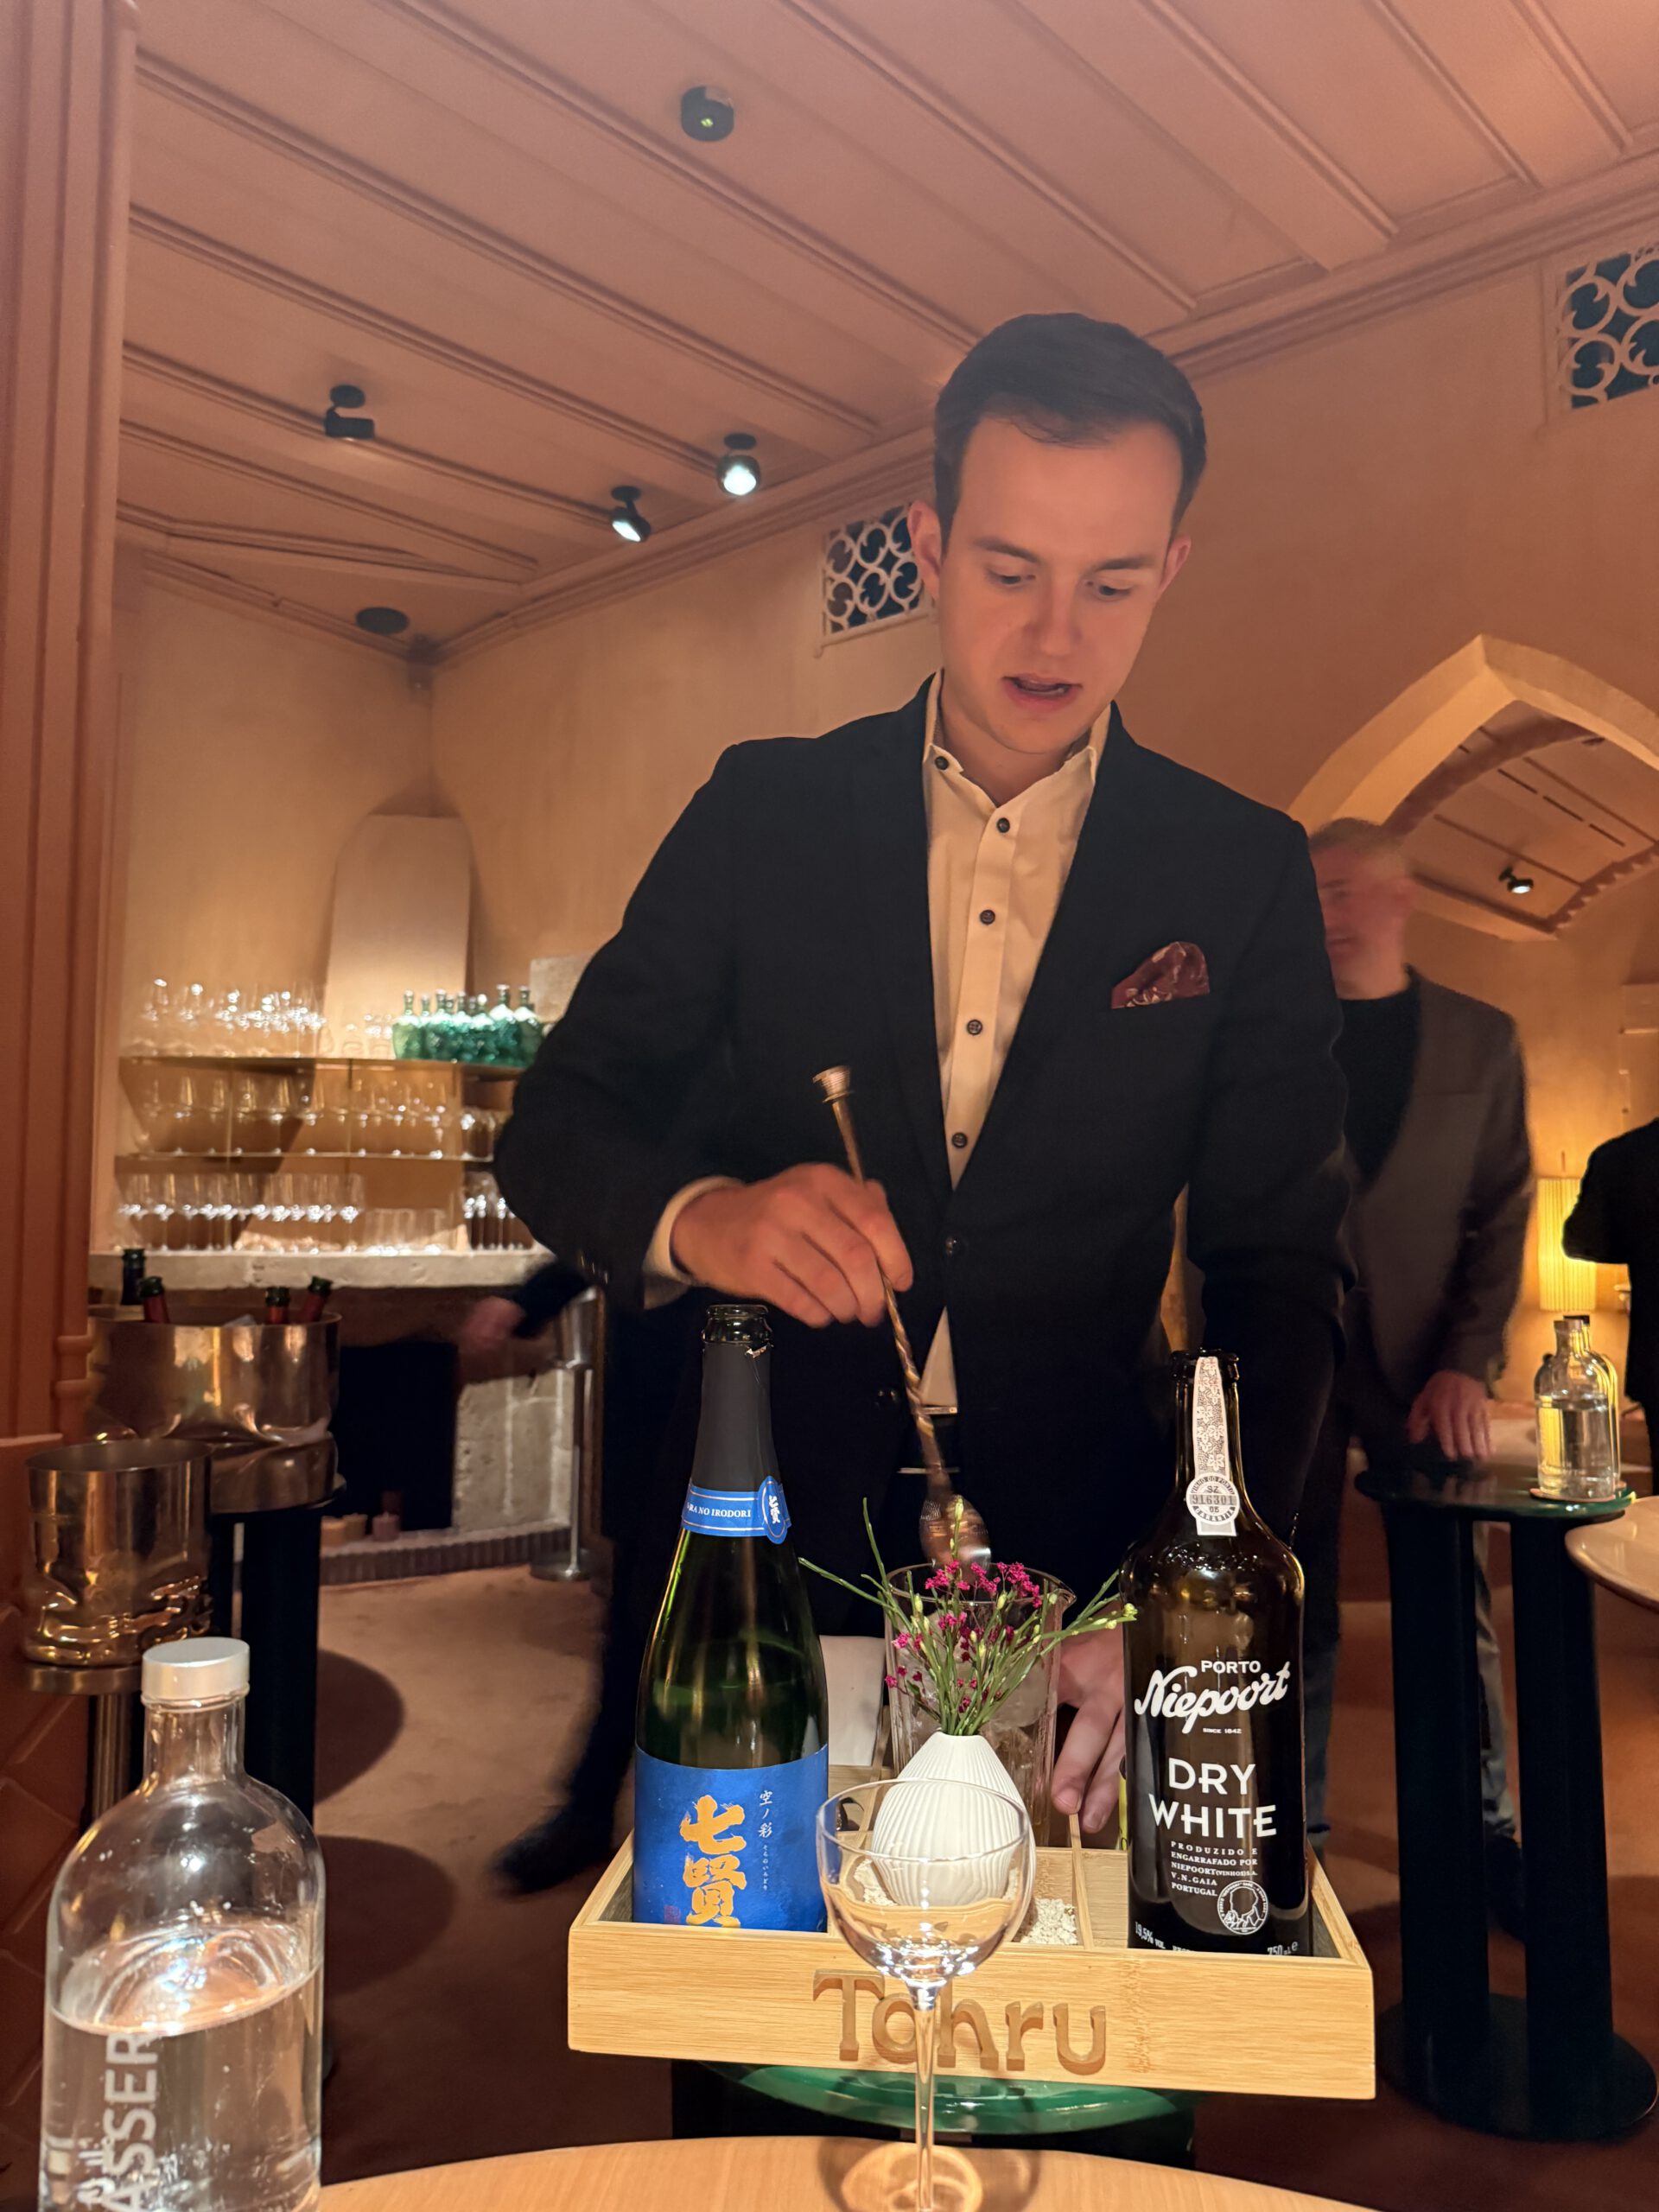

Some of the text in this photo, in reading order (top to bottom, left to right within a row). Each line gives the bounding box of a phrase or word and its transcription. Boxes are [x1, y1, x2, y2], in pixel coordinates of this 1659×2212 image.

[1192, 1494, 1233, 1505] 916301
[698, 1506, 710, 1516] NO
[711, 1508, 752, 1518] IRODORI
[1201, 1660, 1261, 1674] PORTO
[1135, 1661, 1291, 1734] Niepoort
[1168, 1758, 1255, 1795] DRY
[1148, 1793, 1276, 1838] WHITE
[1171, 1840, 1244, 1855] PRODUZIDO
[679, 1795, 747, 1928] 七賢
[1171, 1851, 1236, 1866] ENGARRAFADO
[1171, 1882, 1218, 1896] PORTUGAL
[812, 1968, 1107, 2075] Tohru
